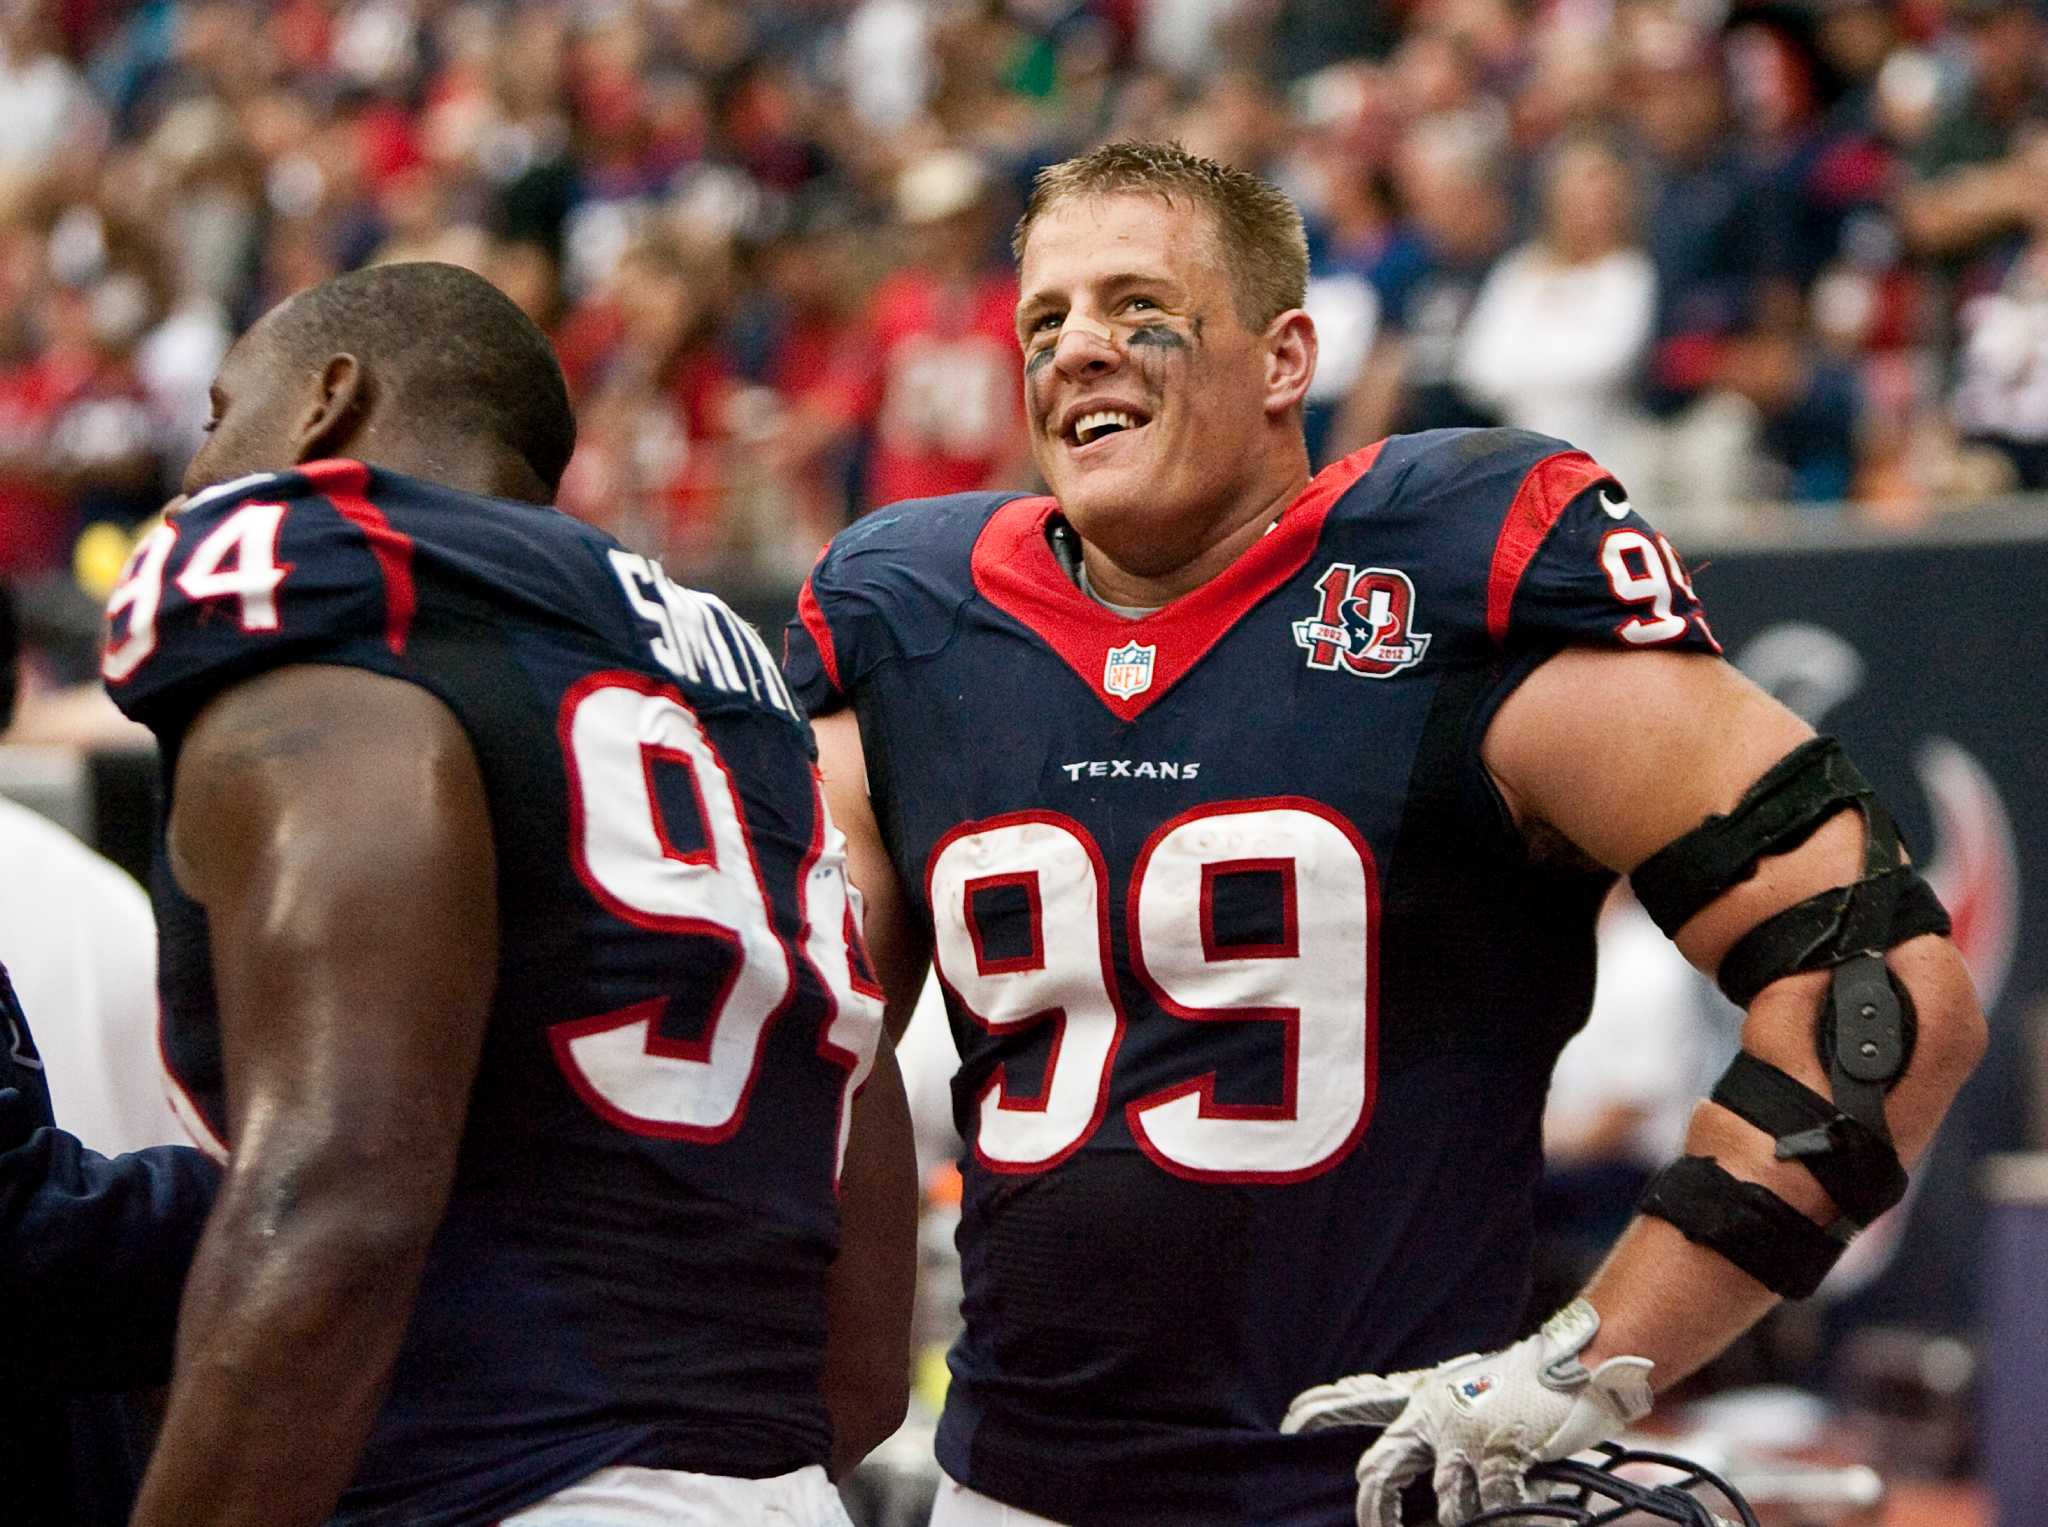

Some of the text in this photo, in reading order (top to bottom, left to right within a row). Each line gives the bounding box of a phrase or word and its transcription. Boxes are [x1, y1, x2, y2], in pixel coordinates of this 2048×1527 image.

[99, 499, 295, 687] 94
[1313, 567, 1412, 675] 10
[1111, 664, 1144, 689] NFL
[1378, 648, 1405, 660] 2012
[1062, 760, 1200, 781] TEXANS
[928, 797, 1377, 1182] 99
